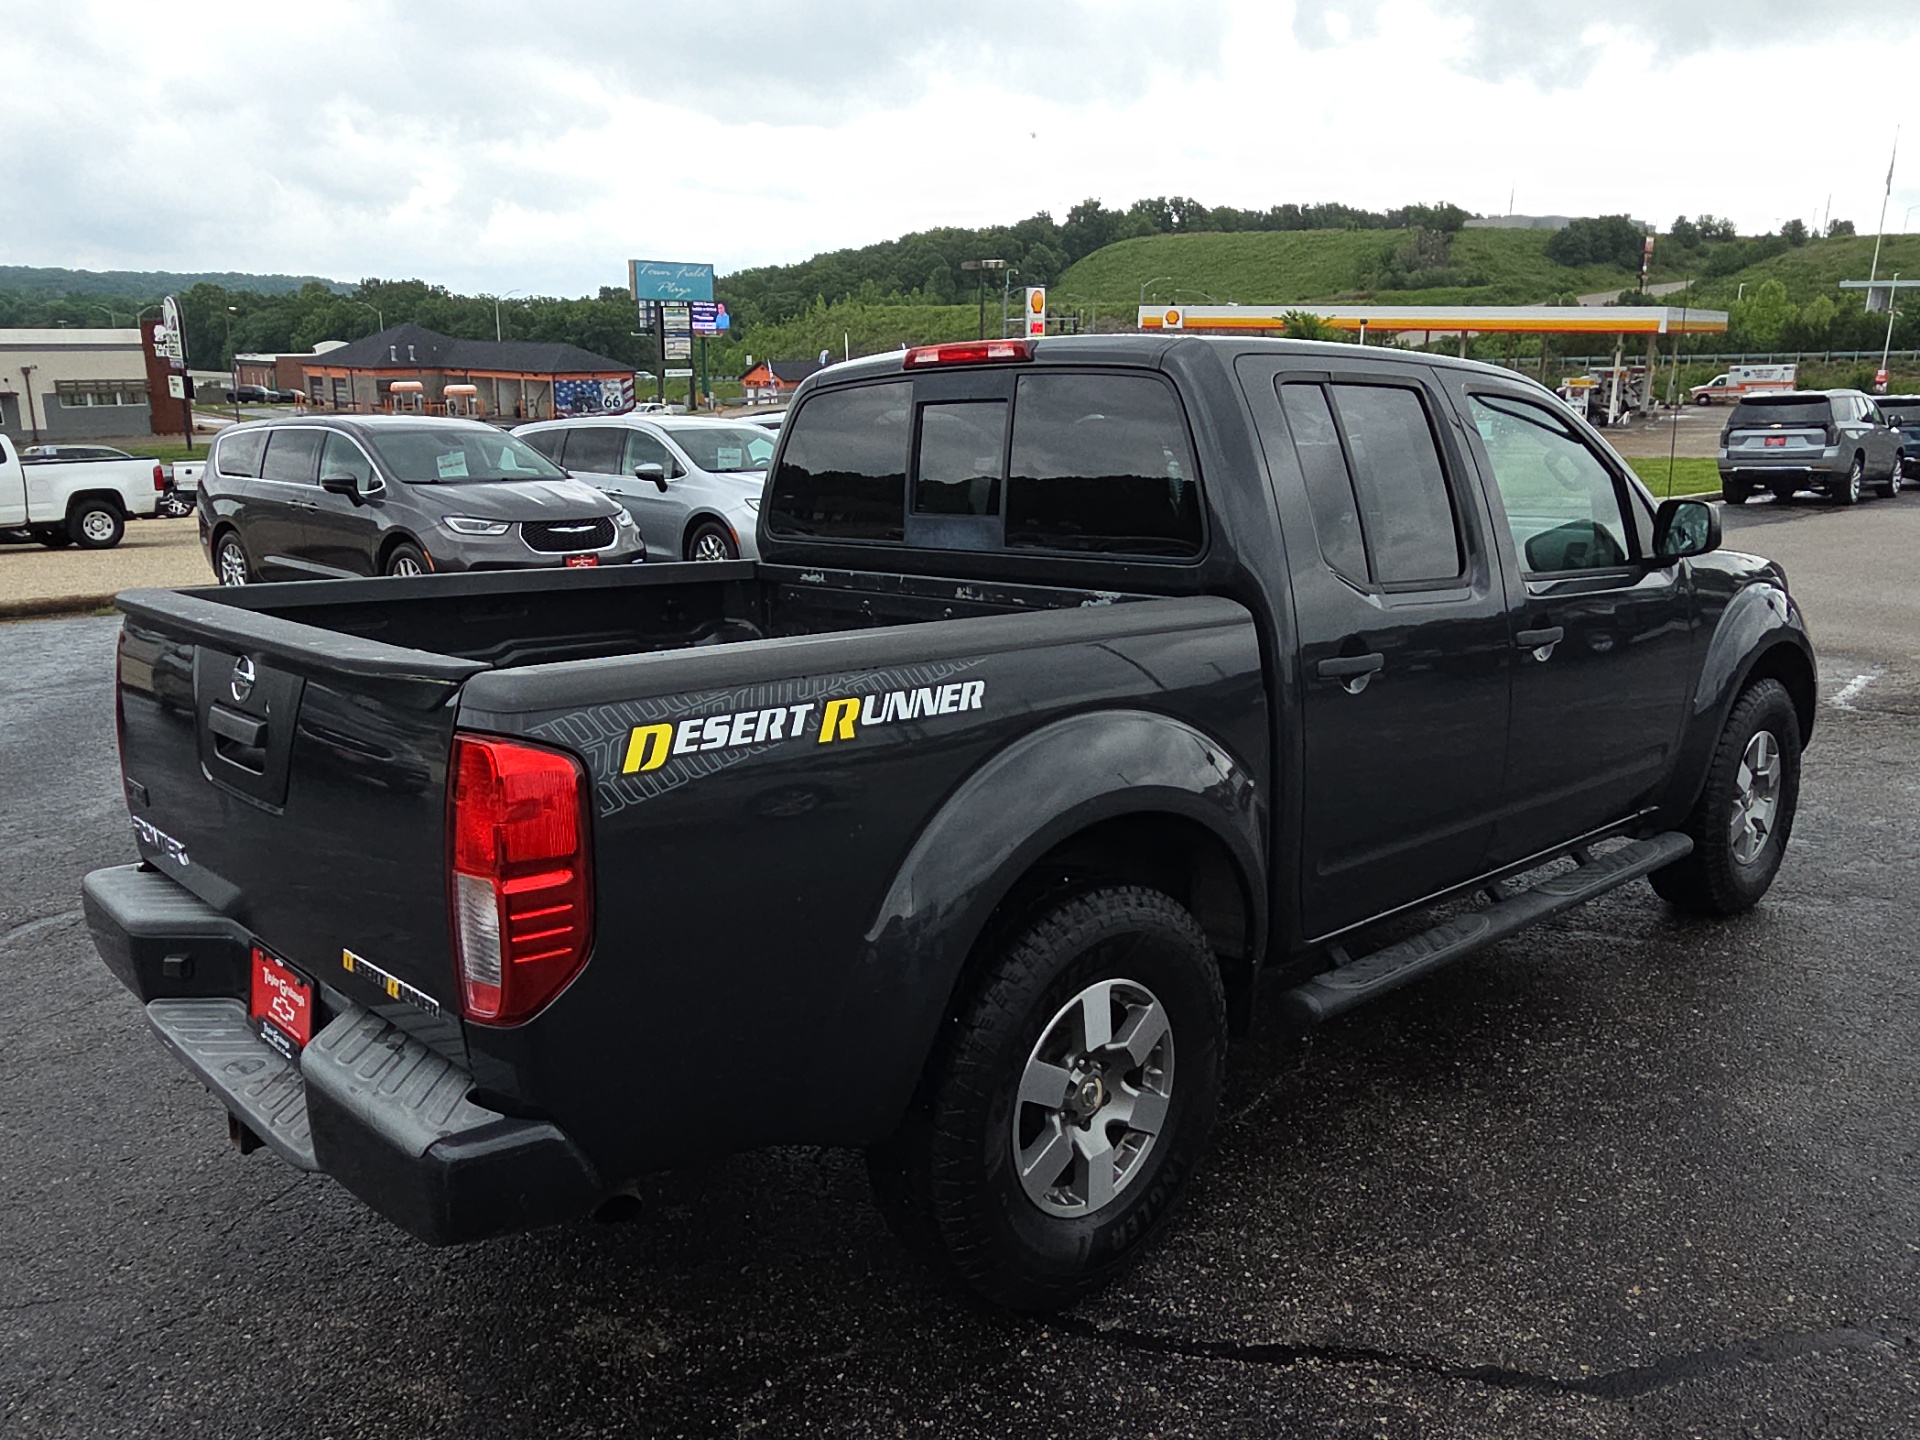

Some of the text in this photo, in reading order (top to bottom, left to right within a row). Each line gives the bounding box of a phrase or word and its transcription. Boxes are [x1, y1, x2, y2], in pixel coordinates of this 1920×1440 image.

[640, 262, 671, 276] Town
[604, 395, 621, 408] 66
[621, 680, 986, 775] DESERT RUNNER
